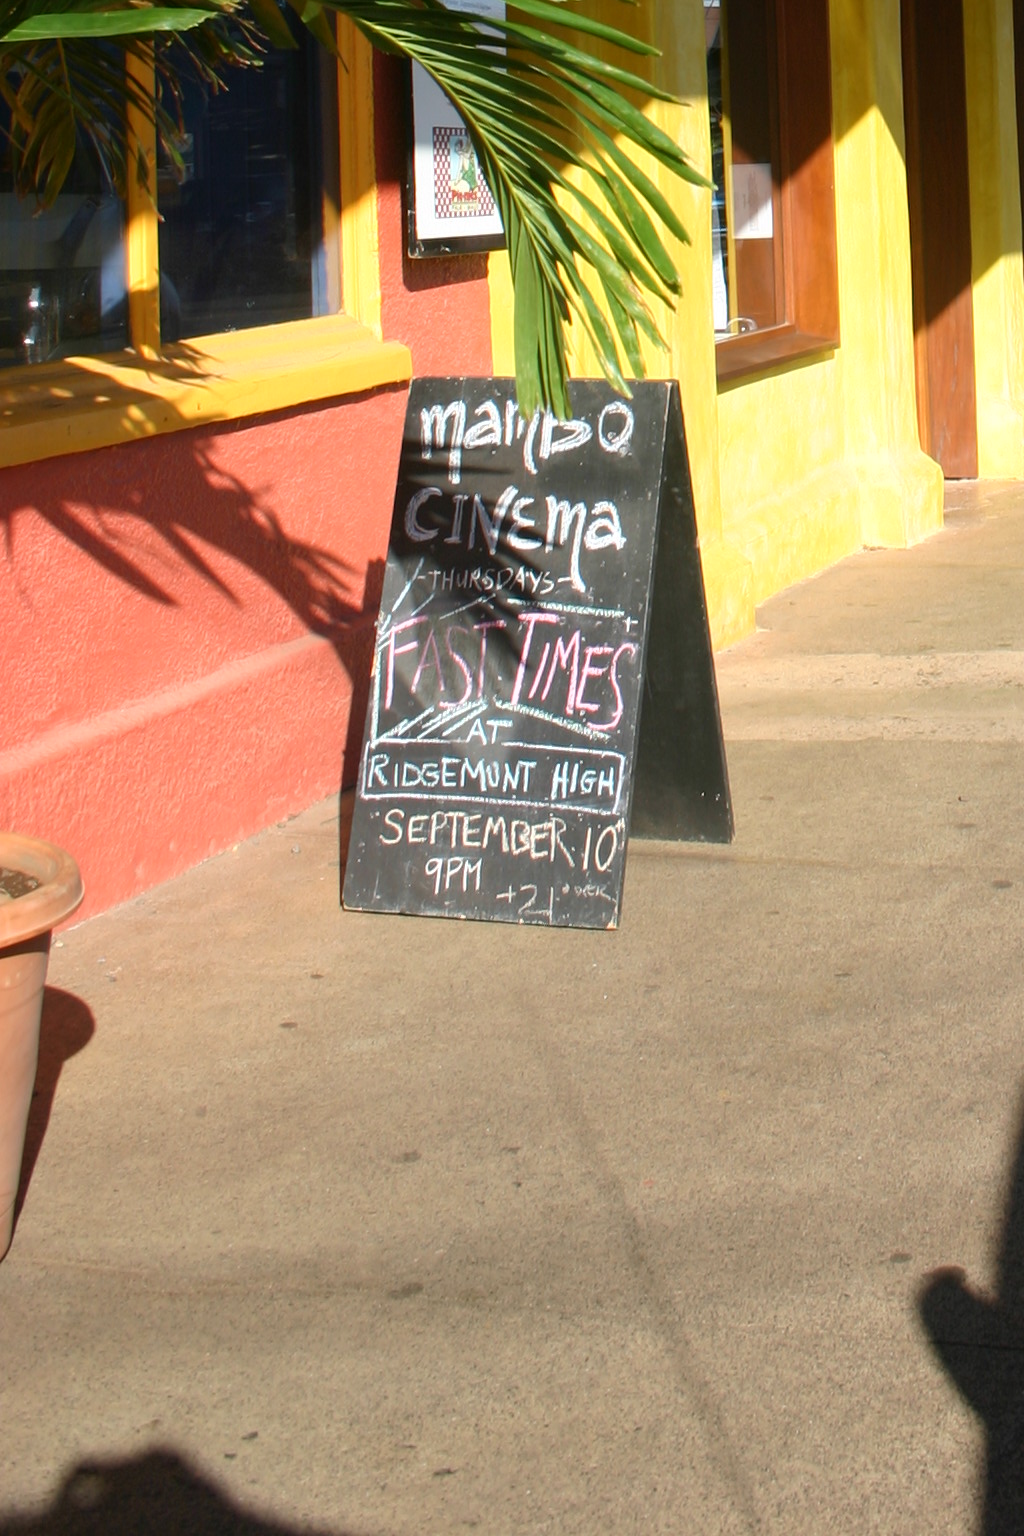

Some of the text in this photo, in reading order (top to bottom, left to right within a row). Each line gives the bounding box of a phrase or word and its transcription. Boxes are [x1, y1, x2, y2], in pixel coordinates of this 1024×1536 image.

[384, 612, 636, 730] FAST TIMES
[466, 717, 514, 746] AT
[550, 760, 616, 800] HIGH
[379, 808, 576, 868] SEPTEMBER
[424, 856, 483, 895] 9PM
